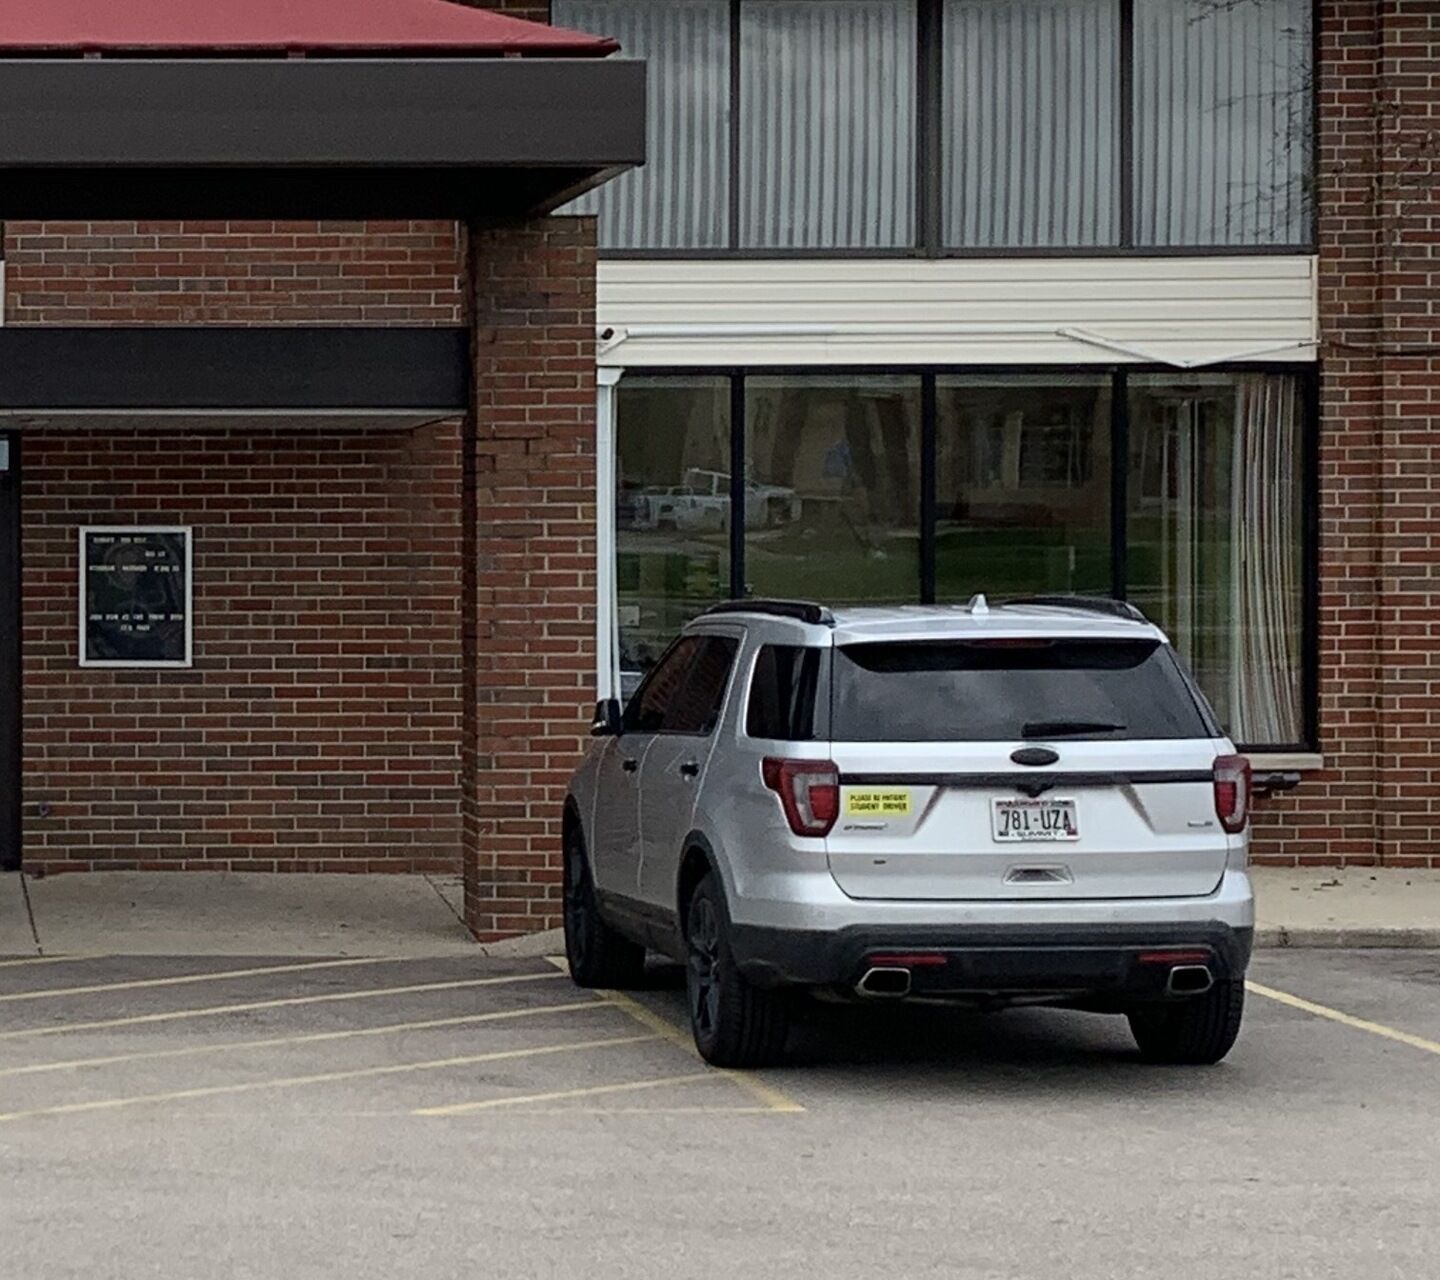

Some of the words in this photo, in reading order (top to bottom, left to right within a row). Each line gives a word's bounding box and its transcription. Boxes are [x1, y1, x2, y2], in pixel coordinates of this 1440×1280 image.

[849, 802, 880, 810] STUDENT
[882, 802, 907, 810] DRIVER
[1000, 809, 1072, 831] 781-UZA
